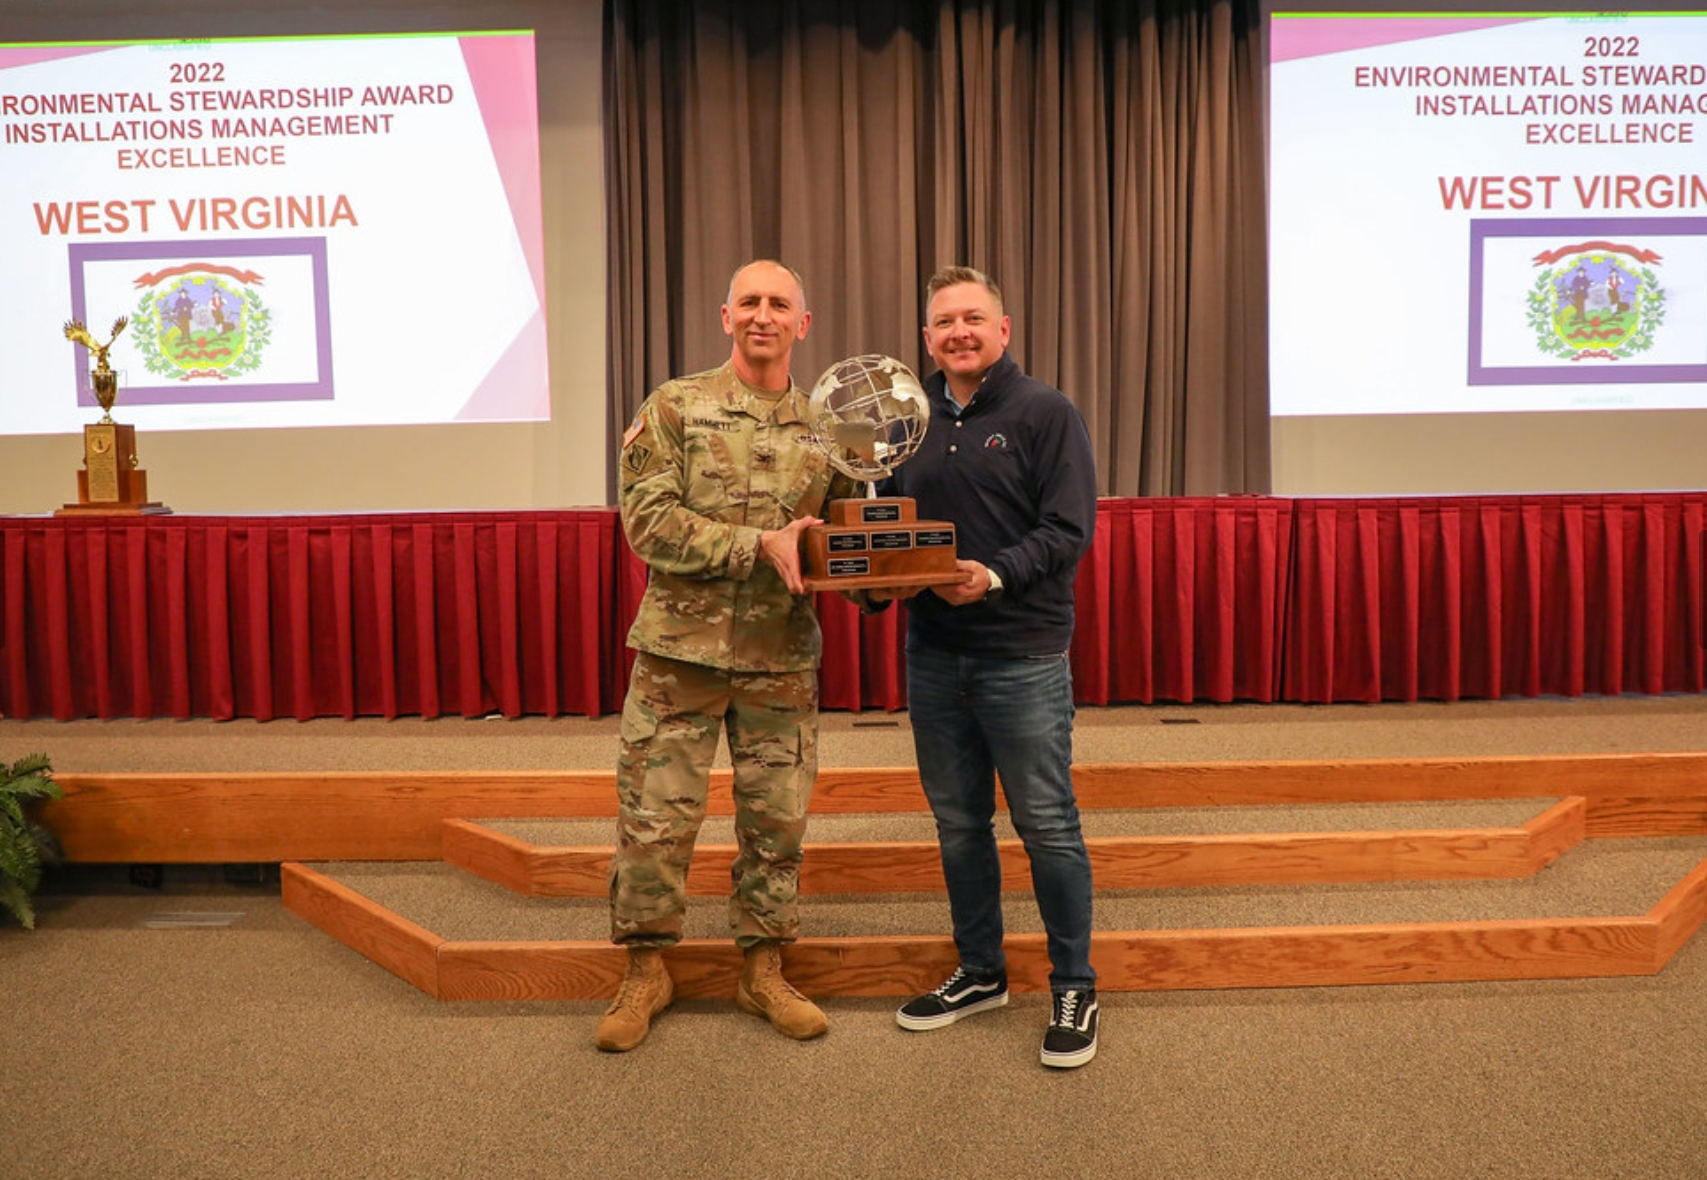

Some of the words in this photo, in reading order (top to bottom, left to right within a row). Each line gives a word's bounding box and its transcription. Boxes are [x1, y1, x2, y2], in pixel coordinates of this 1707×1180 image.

[1583, 36, 1640, 57] 2022
[169, 62, 226, 84] 2022
[1354, 66, 1575, 88] ENVIRONMENTAL
[1581, 65, 1707, 87] STEWARD
[169, 87, 354, 112] STEWARDSHIP
[360, 84, 454, 107] AWARD
[1415, 94, 1614, 116] INSTALLATIONS
[5, 119, 204, 145] INSTALLATIONS
[211, 114, 395, 139] MANAGEMENT
[1525, 123, 1694, 145] EXCELLENCE
[117, 146, 286, 170] EXCELLENCE
[1438, 176, 1562, 211] WEST
[1573, 174, 1707, 210] VIRGIN
[33, 200, 157, 236] WEST
[167, 195, 359, 232] VIRGINIA
